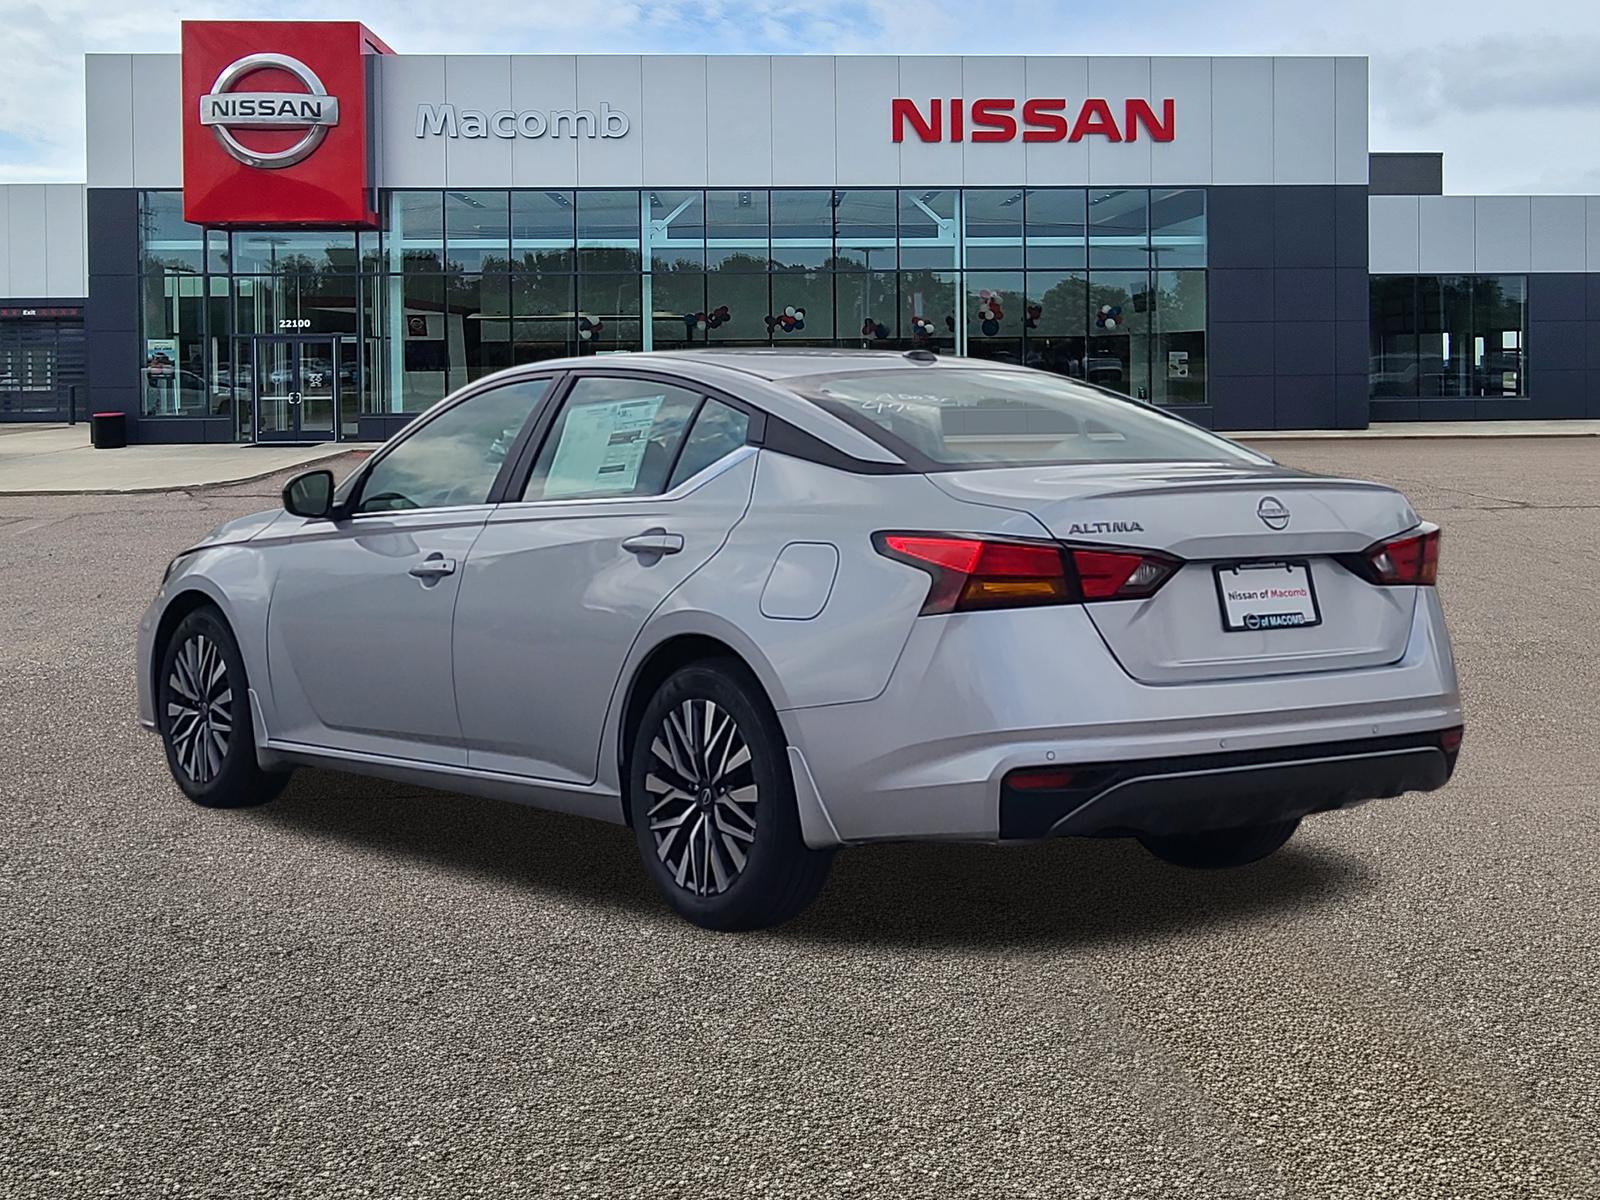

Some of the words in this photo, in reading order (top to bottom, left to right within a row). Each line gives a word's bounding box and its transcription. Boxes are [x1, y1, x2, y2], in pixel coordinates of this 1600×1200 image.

[211, 99, 322, 118] NISSAN
[415, 102, 630, 139] Macomb
[892, 98, 1175, 143] NISSAN
[279, 319, 311, 328] 22100
[1068, 521, 1145, 535] ALTIMA
[1228, 590, 1258, 601] Nissan
[1260, 589, 1269, 599] of
[1270, 588, 1307, 598] Macomb
[1261, 616, 1270, 626] of
[1270, 614, 1305, 626] MACOMB
